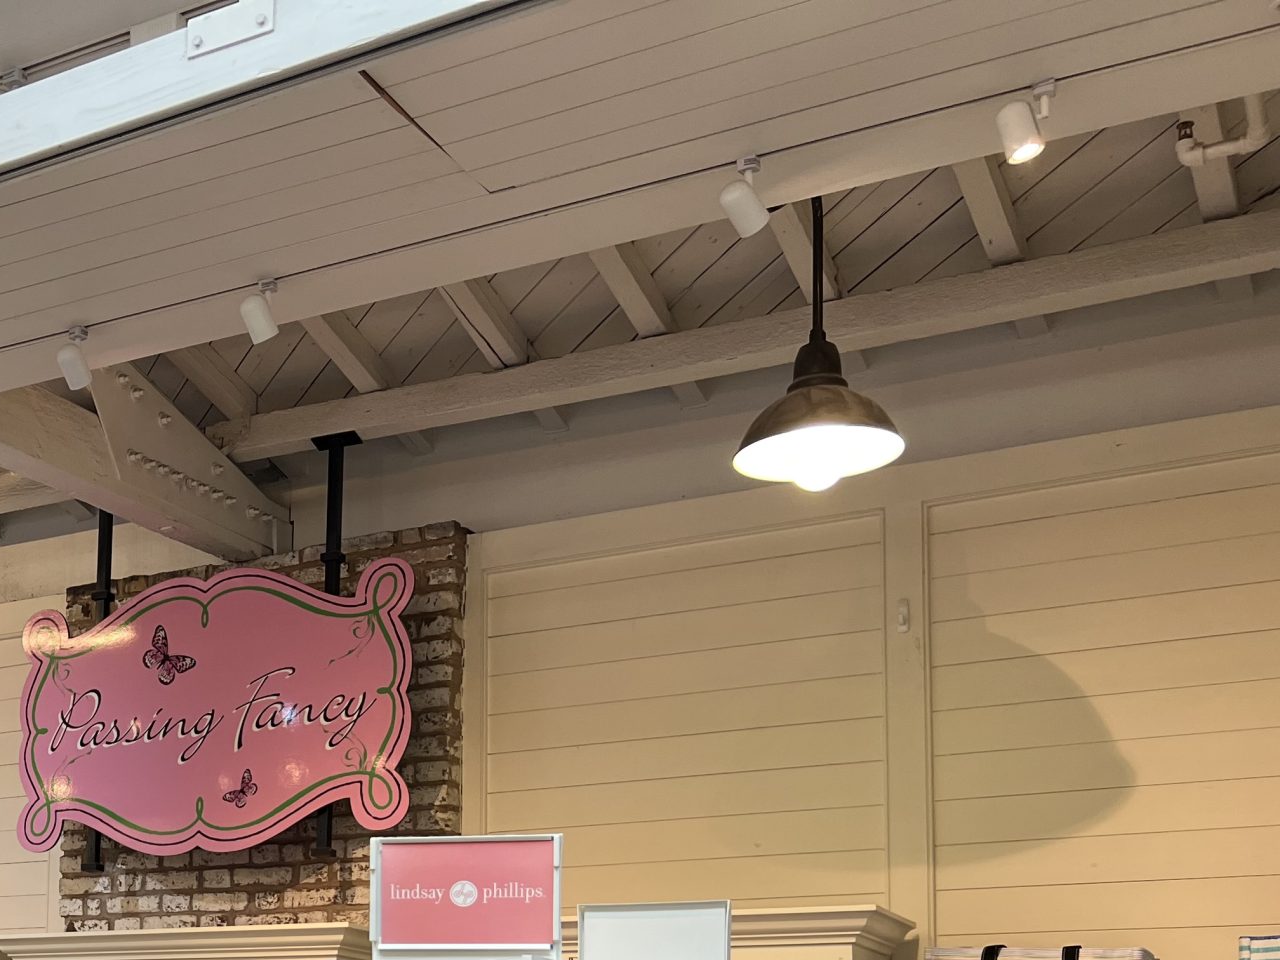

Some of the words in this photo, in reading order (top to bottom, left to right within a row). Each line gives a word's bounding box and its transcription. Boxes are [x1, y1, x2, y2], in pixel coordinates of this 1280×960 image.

[48, 689, 223, 765] Passing
[233, 667, 377, 751] Fancy
[390, 883, 445, 904] lindsay
